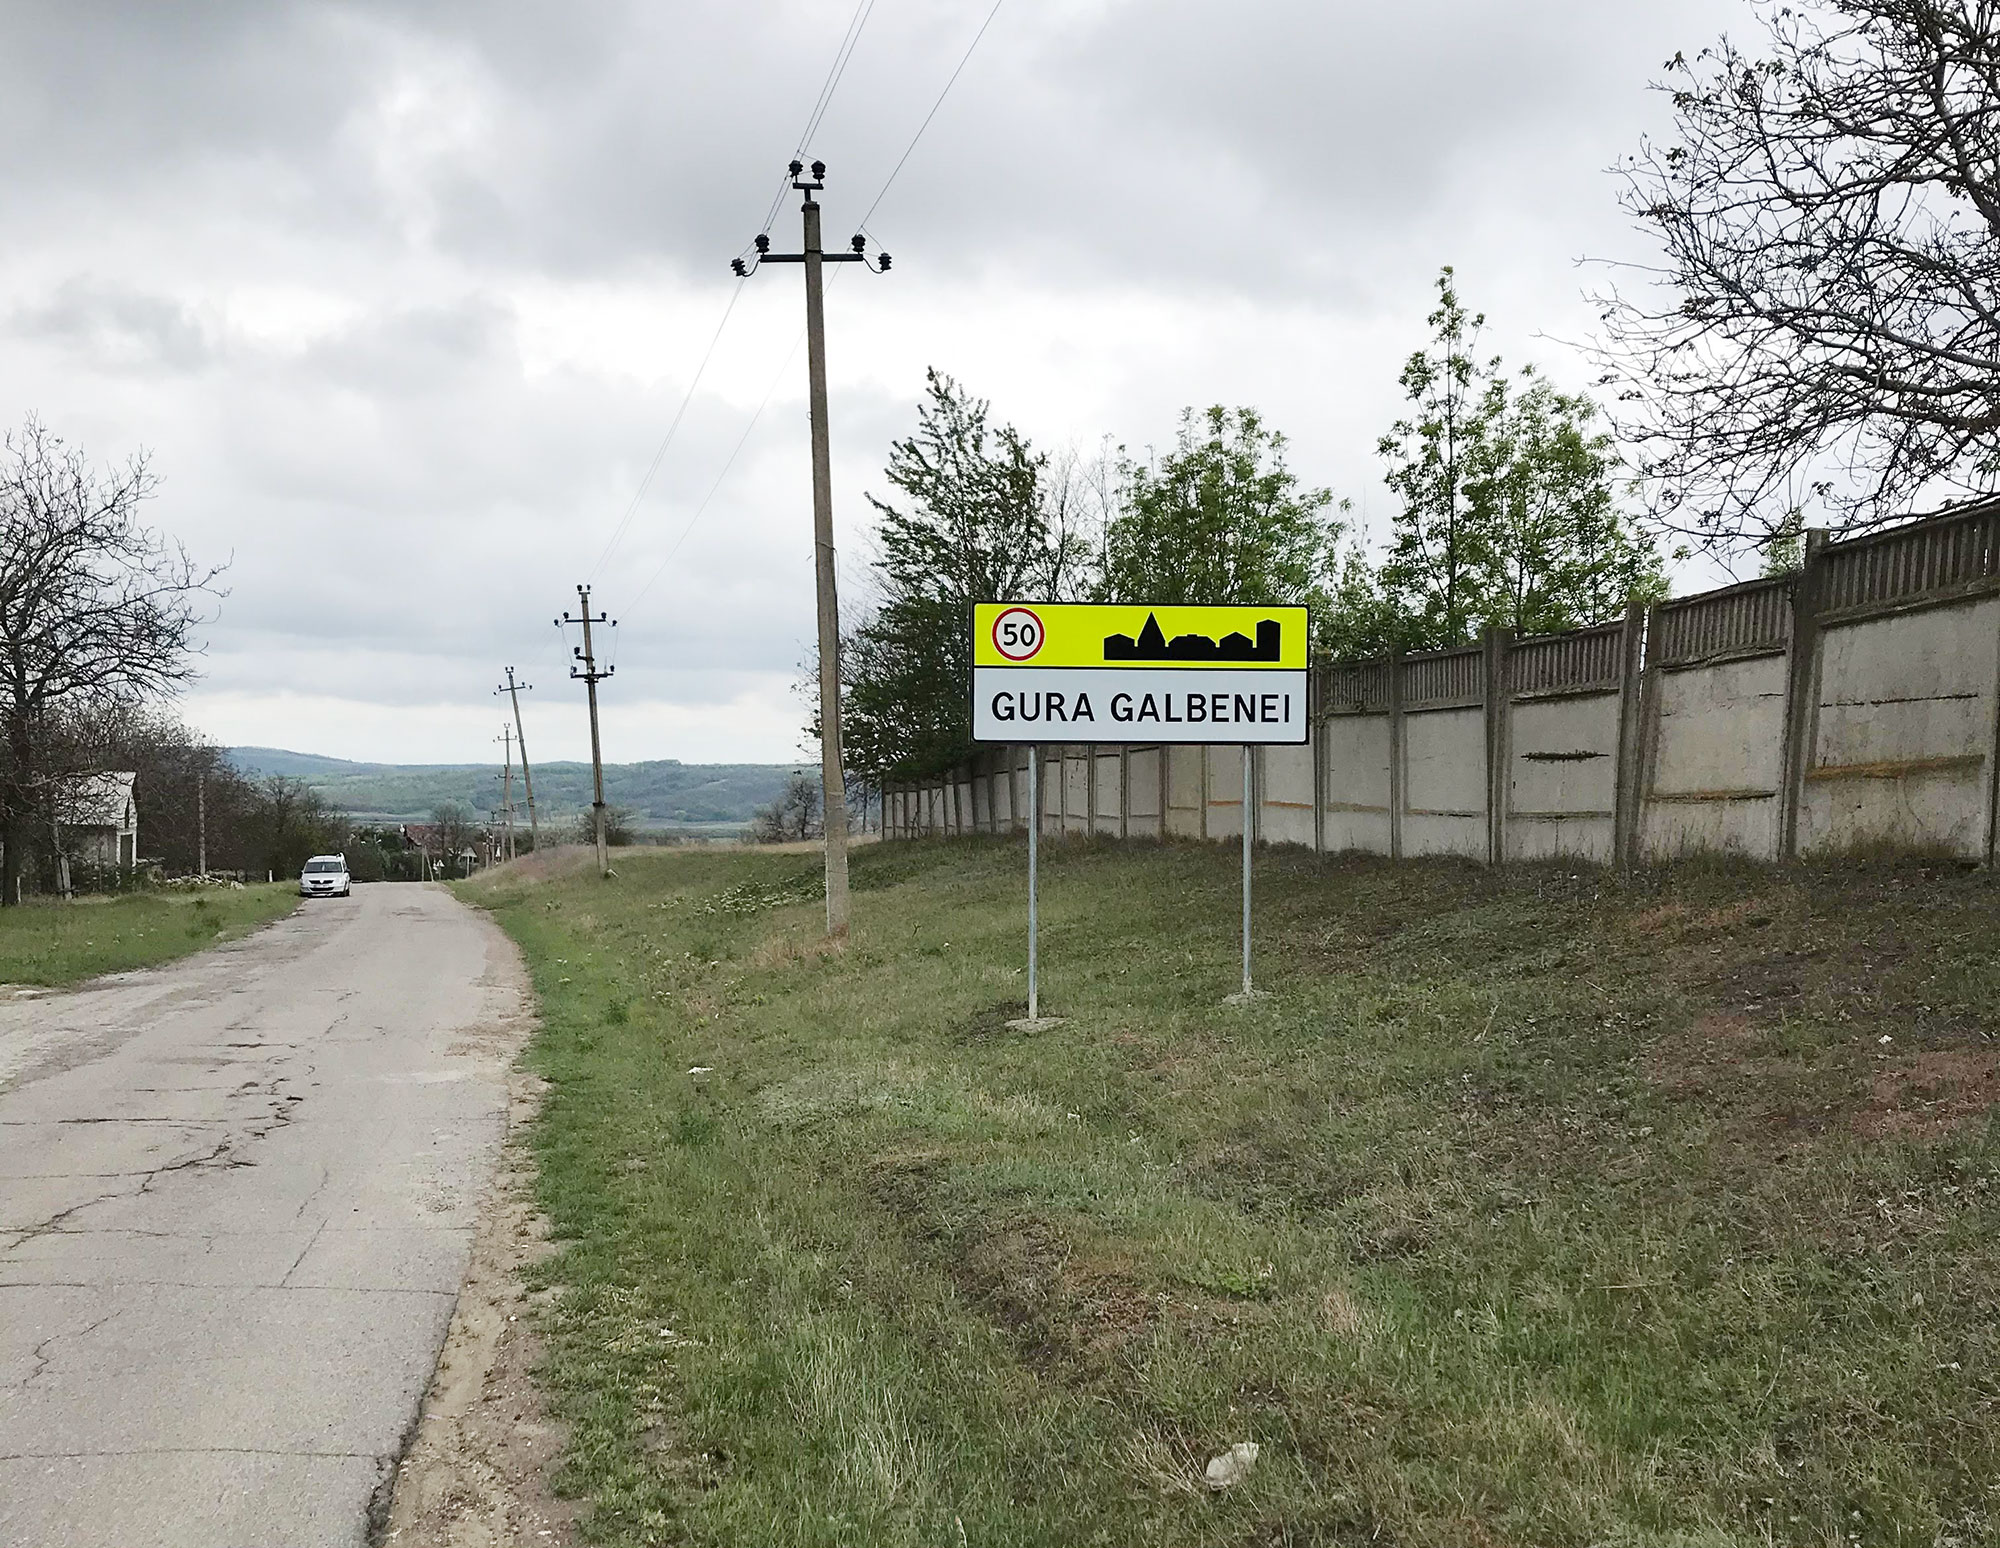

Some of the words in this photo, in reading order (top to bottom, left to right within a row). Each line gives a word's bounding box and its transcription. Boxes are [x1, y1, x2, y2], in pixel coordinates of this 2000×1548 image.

[1002, 622, 1036, 647] 50
[991, 691, 1095, 722] GURA
[1110, 692, 1290, 723] GALBENEI
